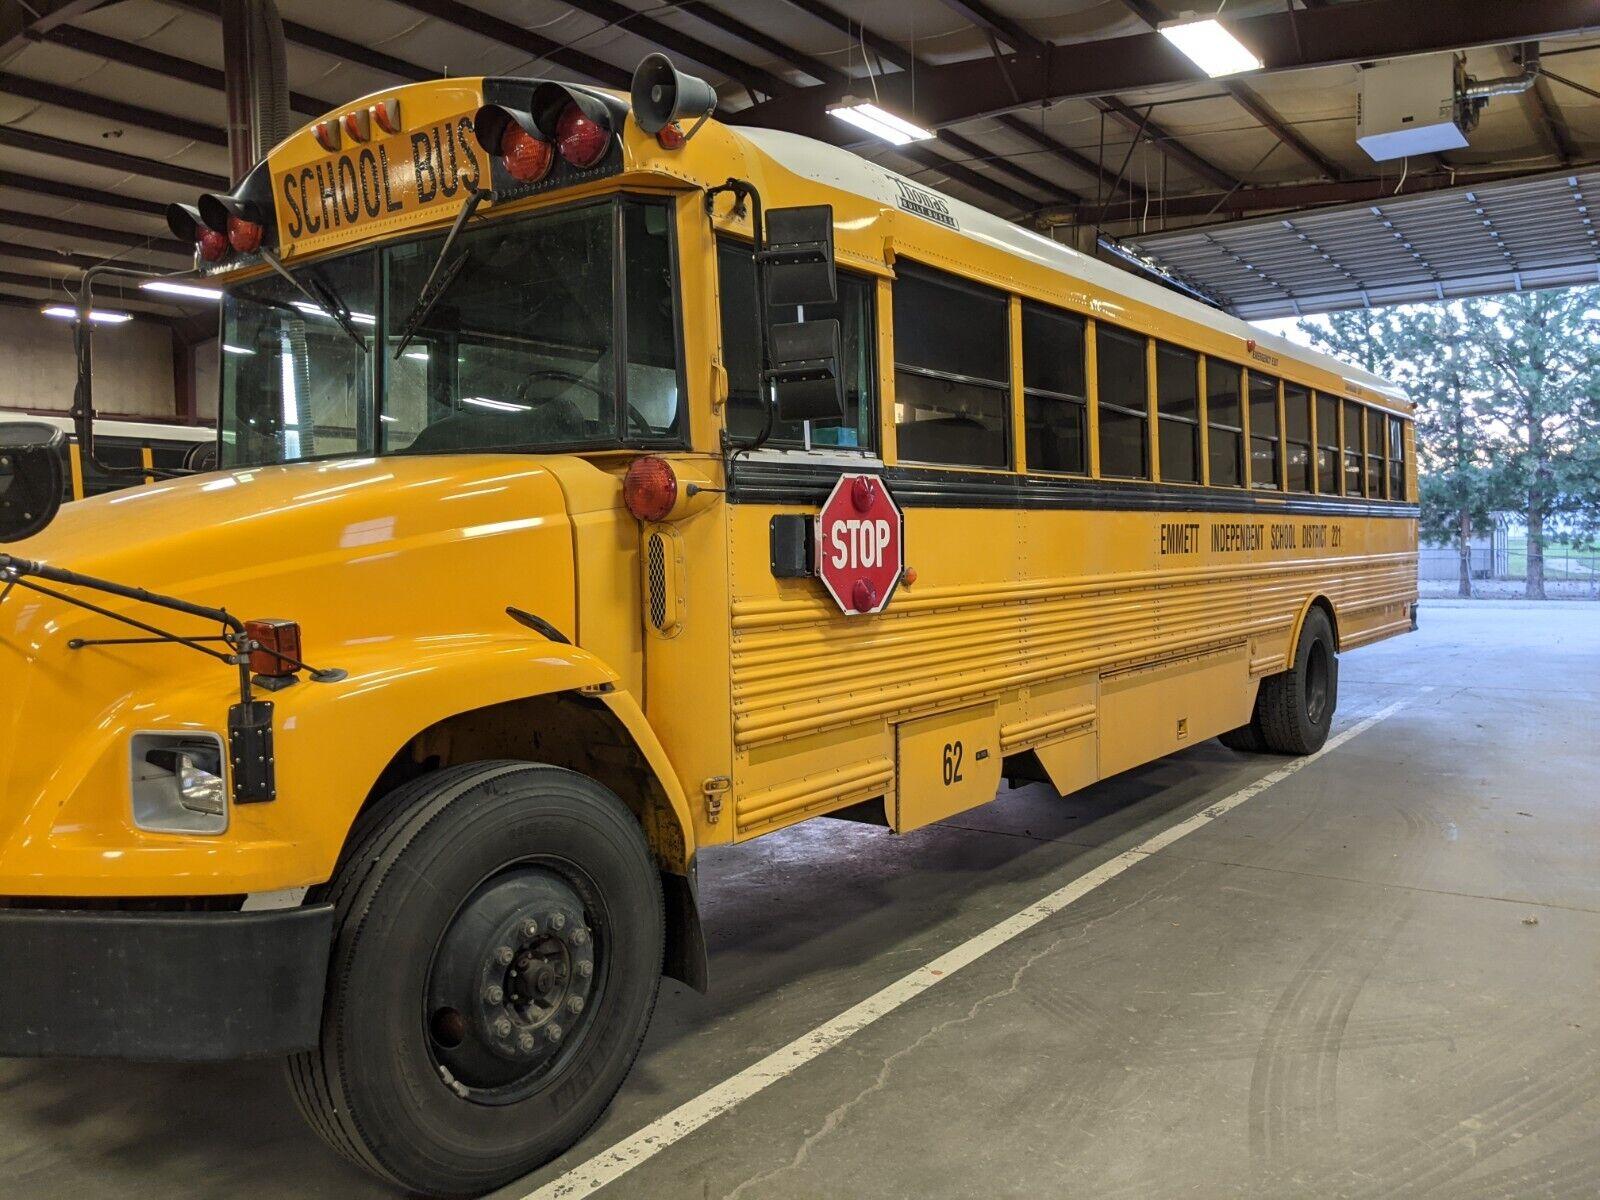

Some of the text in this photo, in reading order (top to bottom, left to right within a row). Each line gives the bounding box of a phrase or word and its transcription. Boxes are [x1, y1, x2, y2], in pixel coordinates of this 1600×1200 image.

[284, 116, 480, 239] SCHOOL BUS
[884, 174, 949, 214] Thomas
[831, 519, 891, 570] STOP
[1161, 524, 1341, 554] EMMETT INDEPENDENT SCHOOL DISTRICT 221
[943, 740, 963, 787] 62
